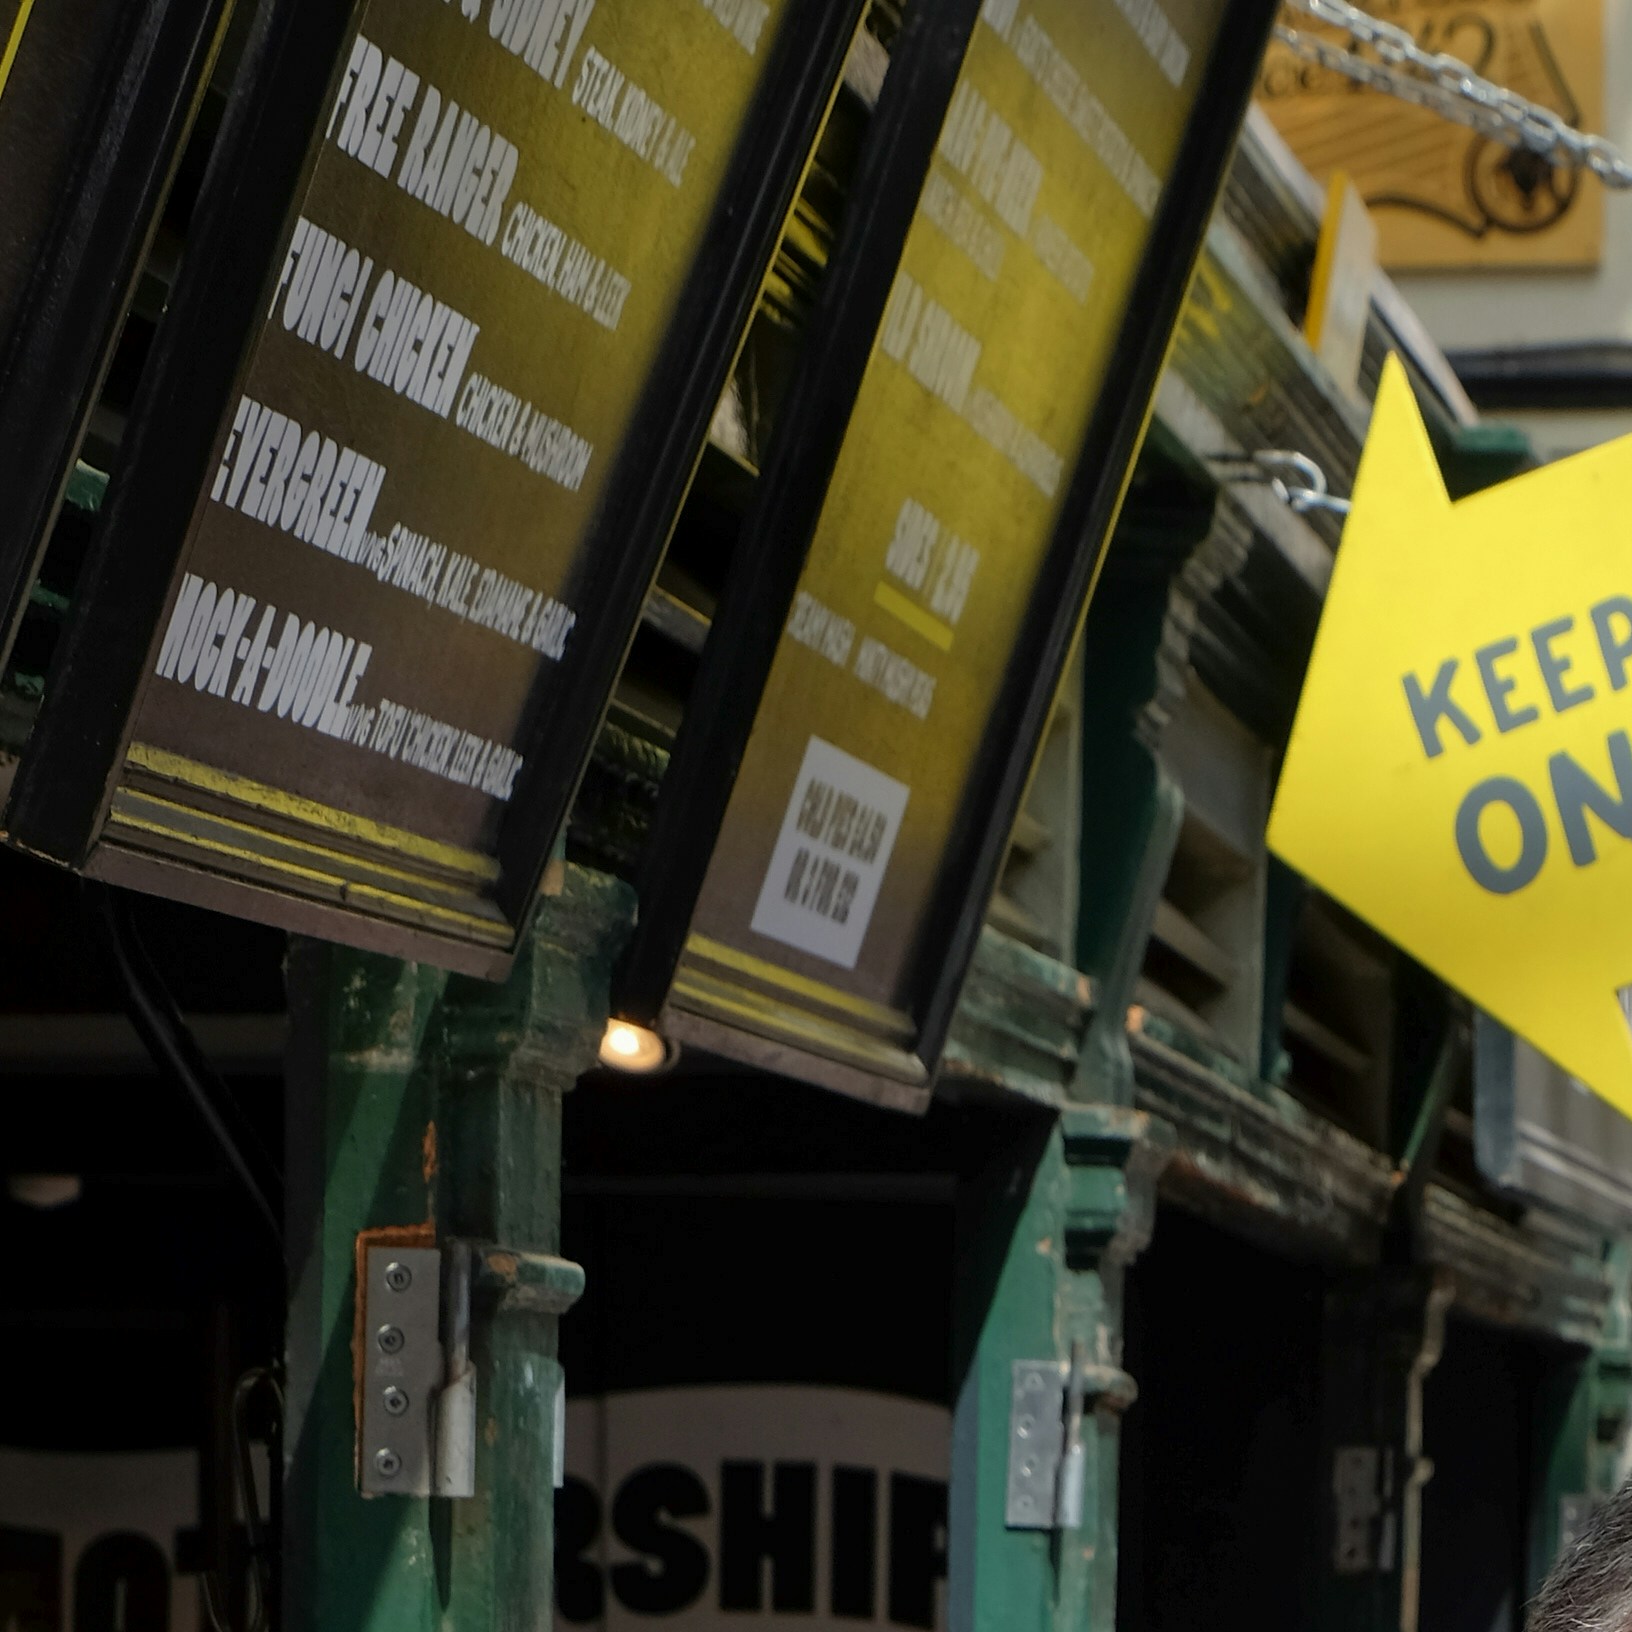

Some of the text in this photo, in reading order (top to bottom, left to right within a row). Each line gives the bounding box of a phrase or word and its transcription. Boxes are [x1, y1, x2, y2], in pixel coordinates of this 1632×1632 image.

[326, 33, 420, 179] FREE
[397, 85, 518, 246] RANGER
[268, 216, 372, 358] FUNGI
[353, 269, 480, 419] CHICKEN
[456, 374, 520, 447] CHICKEN
[210, 394, 387, 564] EVERGREEN
[155, 573, 373, 738] MOCK-A-DOODLE
[369, 699, 410, 757] TOFU
